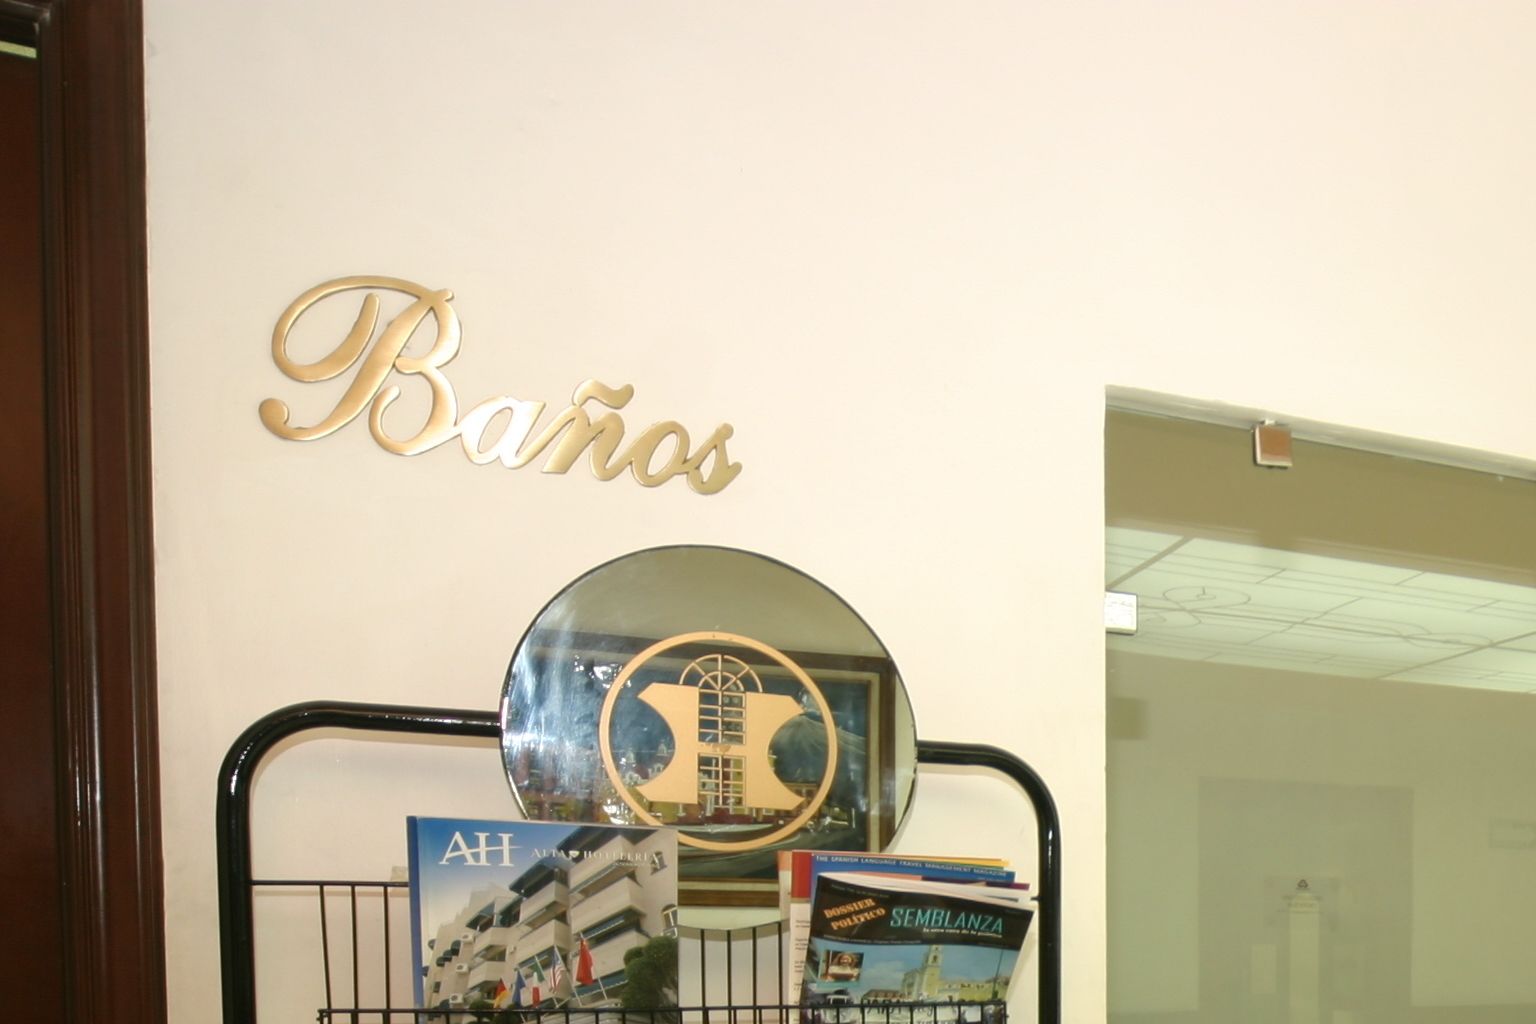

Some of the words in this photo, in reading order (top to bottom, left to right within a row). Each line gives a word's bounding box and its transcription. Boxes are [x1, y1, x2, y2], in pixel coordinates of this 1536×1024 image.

[258, 275, 742, 495] Baños
[438, 831, 516, 867] AH
[815, 855, 829, 863] THE
[831, 856, 859, 864] SPANISH
[860, 857, 896, 866] LANGUAGE
[899, 860, 922, 868] TRAVEL
[823, 898, 876, 920] DOSSIER
[830, 907, 886, 930] POLÍTICO
[890, 906, 1003, 933] SEMBLANZA
